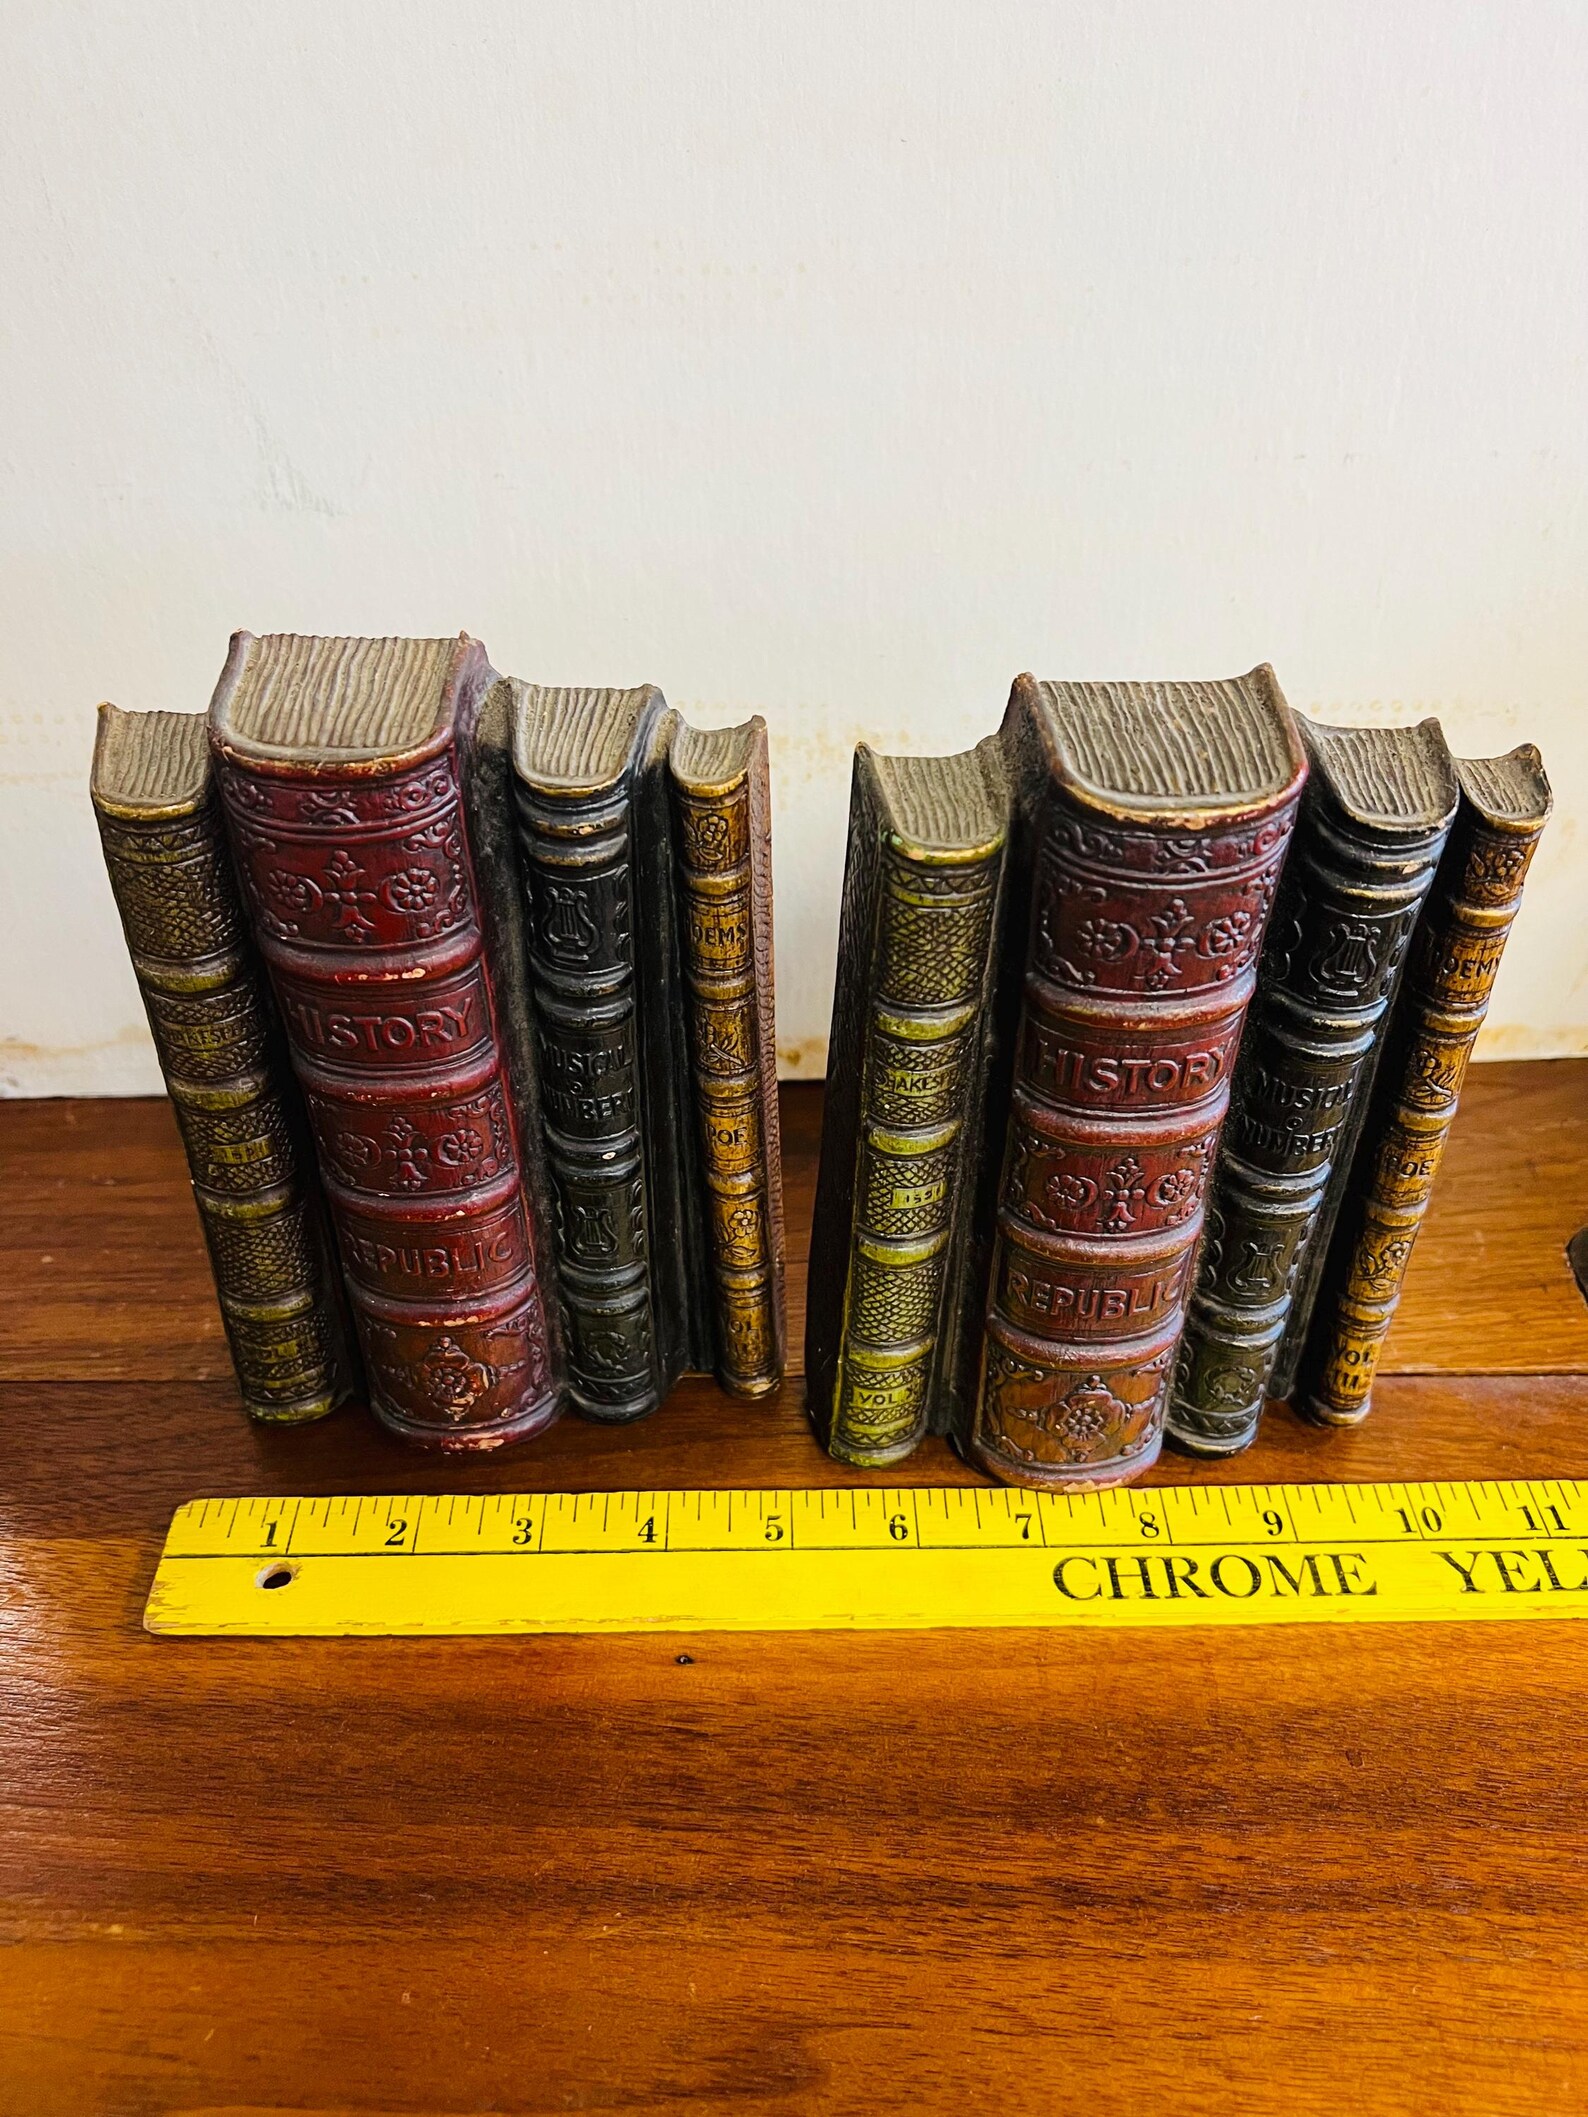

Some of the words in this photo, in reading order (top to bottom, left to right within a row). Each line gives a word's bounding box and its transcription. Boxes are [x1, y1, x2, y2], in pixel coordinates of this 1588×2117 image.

[1040, 1036, 1235, 1094] HISTORY
[704, 1123, 748, 1146] POE
[1008, 1266, 1183, 1320] REPUBLIC
[857, 1391, 897, 1405] VOL
[260, 1520, 278, 1548] 1
[384, 1519, 408, 1546] 2
[512, 1517, 533, 1545] 3
[637, 1516, 658, 1543] 4
[764, 1515, 784, 1542] 5
[889, 1514, 908, 1541] 6
[1014, 1513, 1032, 1540] 7
[1139, 1511, 1160, 1538] 8
[1263, 1510, 1283, 1537] 9
[1393, 1506, 1442, 1533] 10
[1516, 1504, 1571, 1531] 11
[1052, 1552, 1378, 1601] CHROME
[1430, 1548, 1588, 1594] YEL
